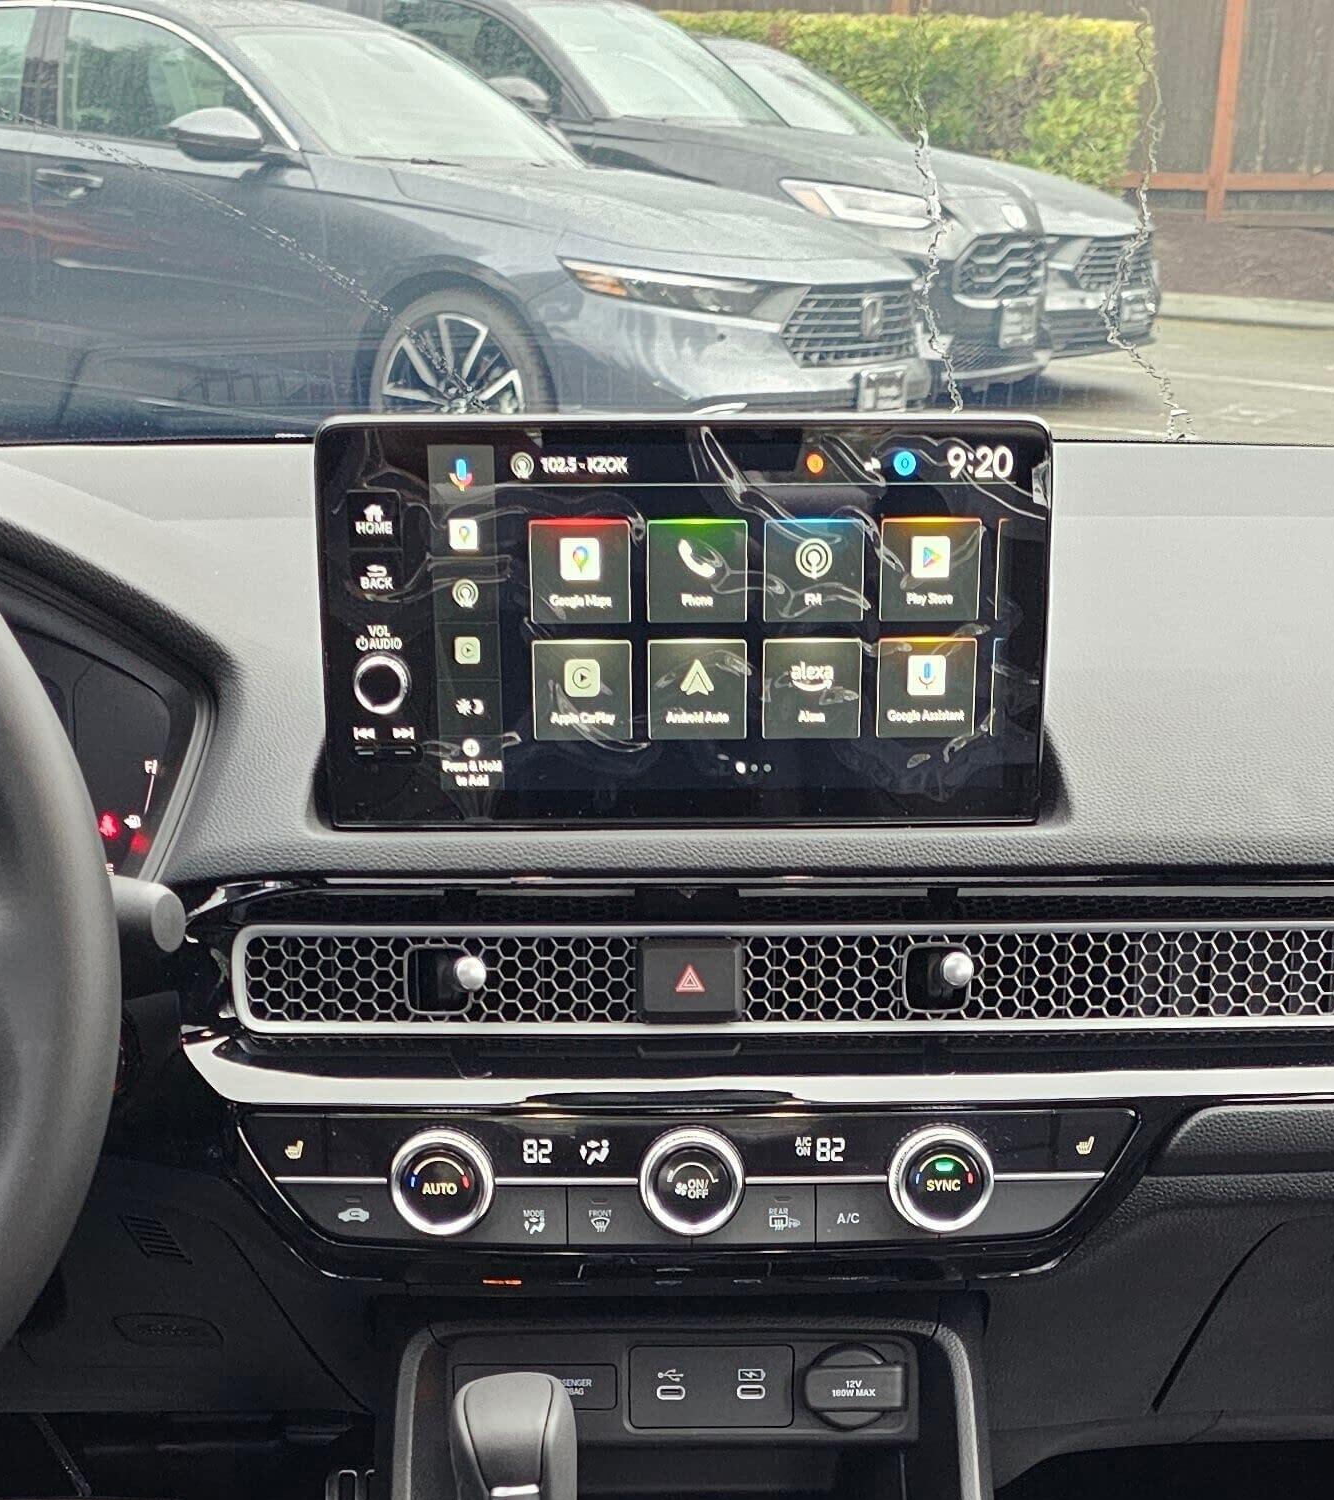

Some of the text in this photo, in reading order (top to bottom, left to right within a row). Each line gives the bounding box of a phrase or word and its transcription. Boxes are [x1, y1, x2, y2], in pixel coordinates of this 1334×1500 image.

[540, 456, 629, 474] 102.5 KZOK
[947, 447, 1014, 478] 9:20
[356, 521, 393, 535] HOME
[360, 576, 394, 590] BACK
[549, 594, 612, 609] Google Maps
[681, 593, 714, 607] Phone
[805, 592, 822, 606] FM
[906, 592, 953, 606] Play Store
[367, 624, 390, 638] VOL
[369, 637, 403, 650] AUDIO
[790, 661, 834, 681] alexa
[550, 711, 616, 726] Apple CarPlay
[666, 711, 729, 724] Android Auto
[887, 709, 965, 724] Google Assistant
[478, 760, 503, 773] Hold
[468, 775, 489, 787] Add
[795, 1136, 812, 1148] A/C
[523, 1138, 552, 1164] 82
[796, 1147, 811, 1158] ON
[815, 1137, 845, 1162] 82
[422, 1182, 458, 1197] AUTO
[687, 1178, 709, 1189] ON/
[926, 1178, 961, 1193] SYNC
[687, 1188, 709, 1200] OFF
[523, 1209, 545, 1218] MODE
[588, 1209, 612, 1218] FRONT
[768, 1207, 789, 1216] REAR
[836, 1212, 860, 1225] A/C
[845, 1380, 863, 1389] 12V
[855, 1388, 876, 1398] MAX
